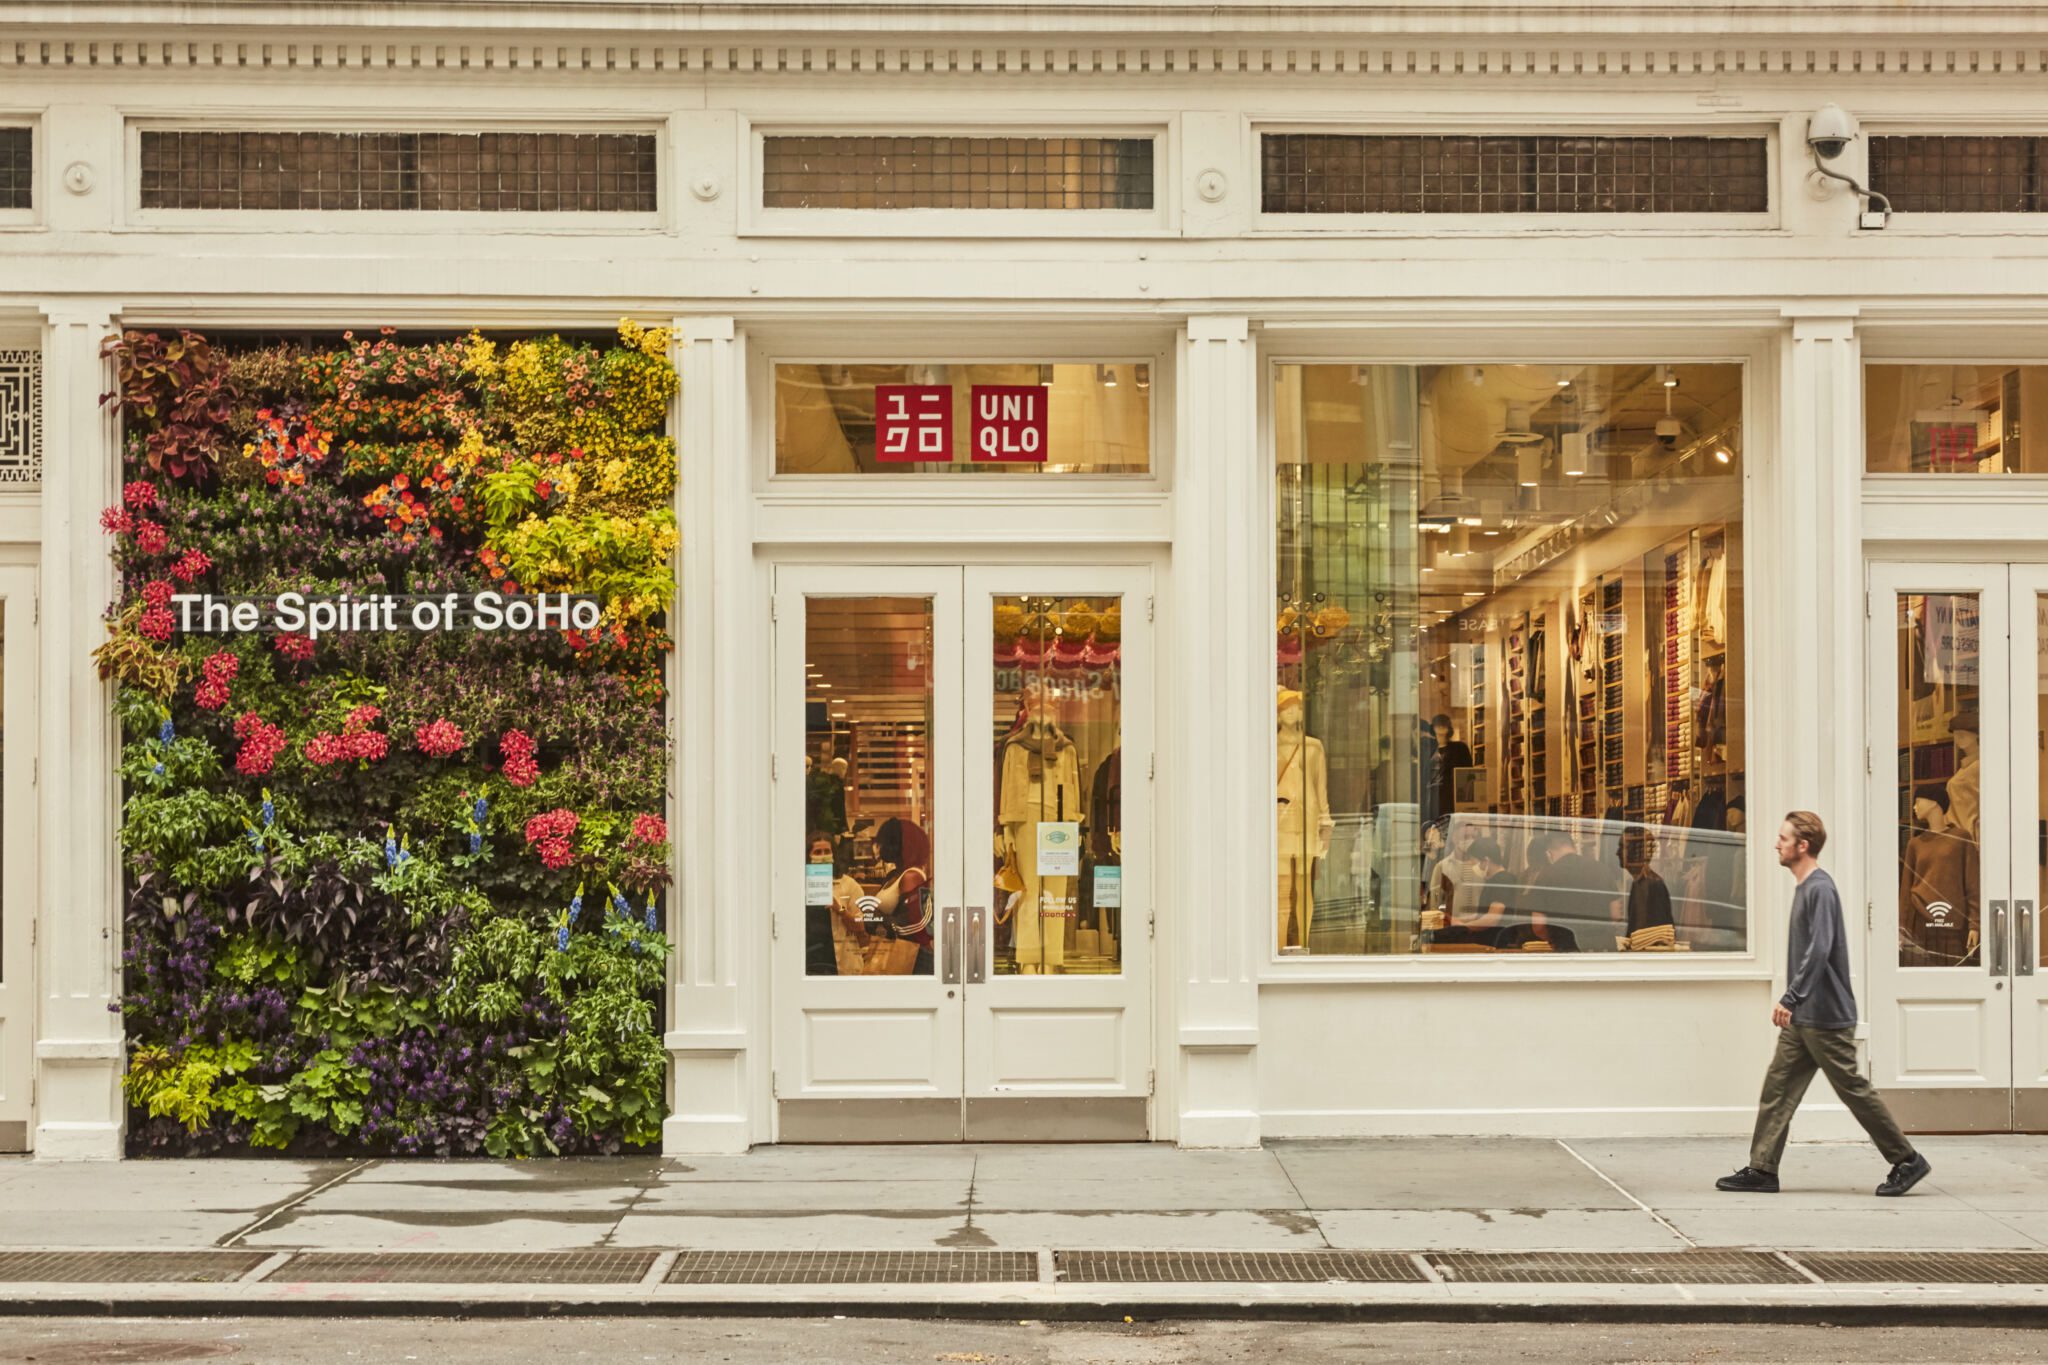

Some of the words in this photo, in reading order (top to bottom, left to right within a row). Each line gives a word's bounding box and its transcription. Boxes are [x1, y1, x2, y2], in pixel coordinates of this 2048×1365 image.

[886, 395, 942, 420] ユニ
[980, 395, 1033, 421] UNI
[884, 427, 942, 452] クロ
[979, 426, 1039, 457] QLO
[171, 594, 259, 632] The
[274, 592, 398, 640] Spirit
[412, 592, 458, 631] of
[473, 592, 601, 631] SoHo
